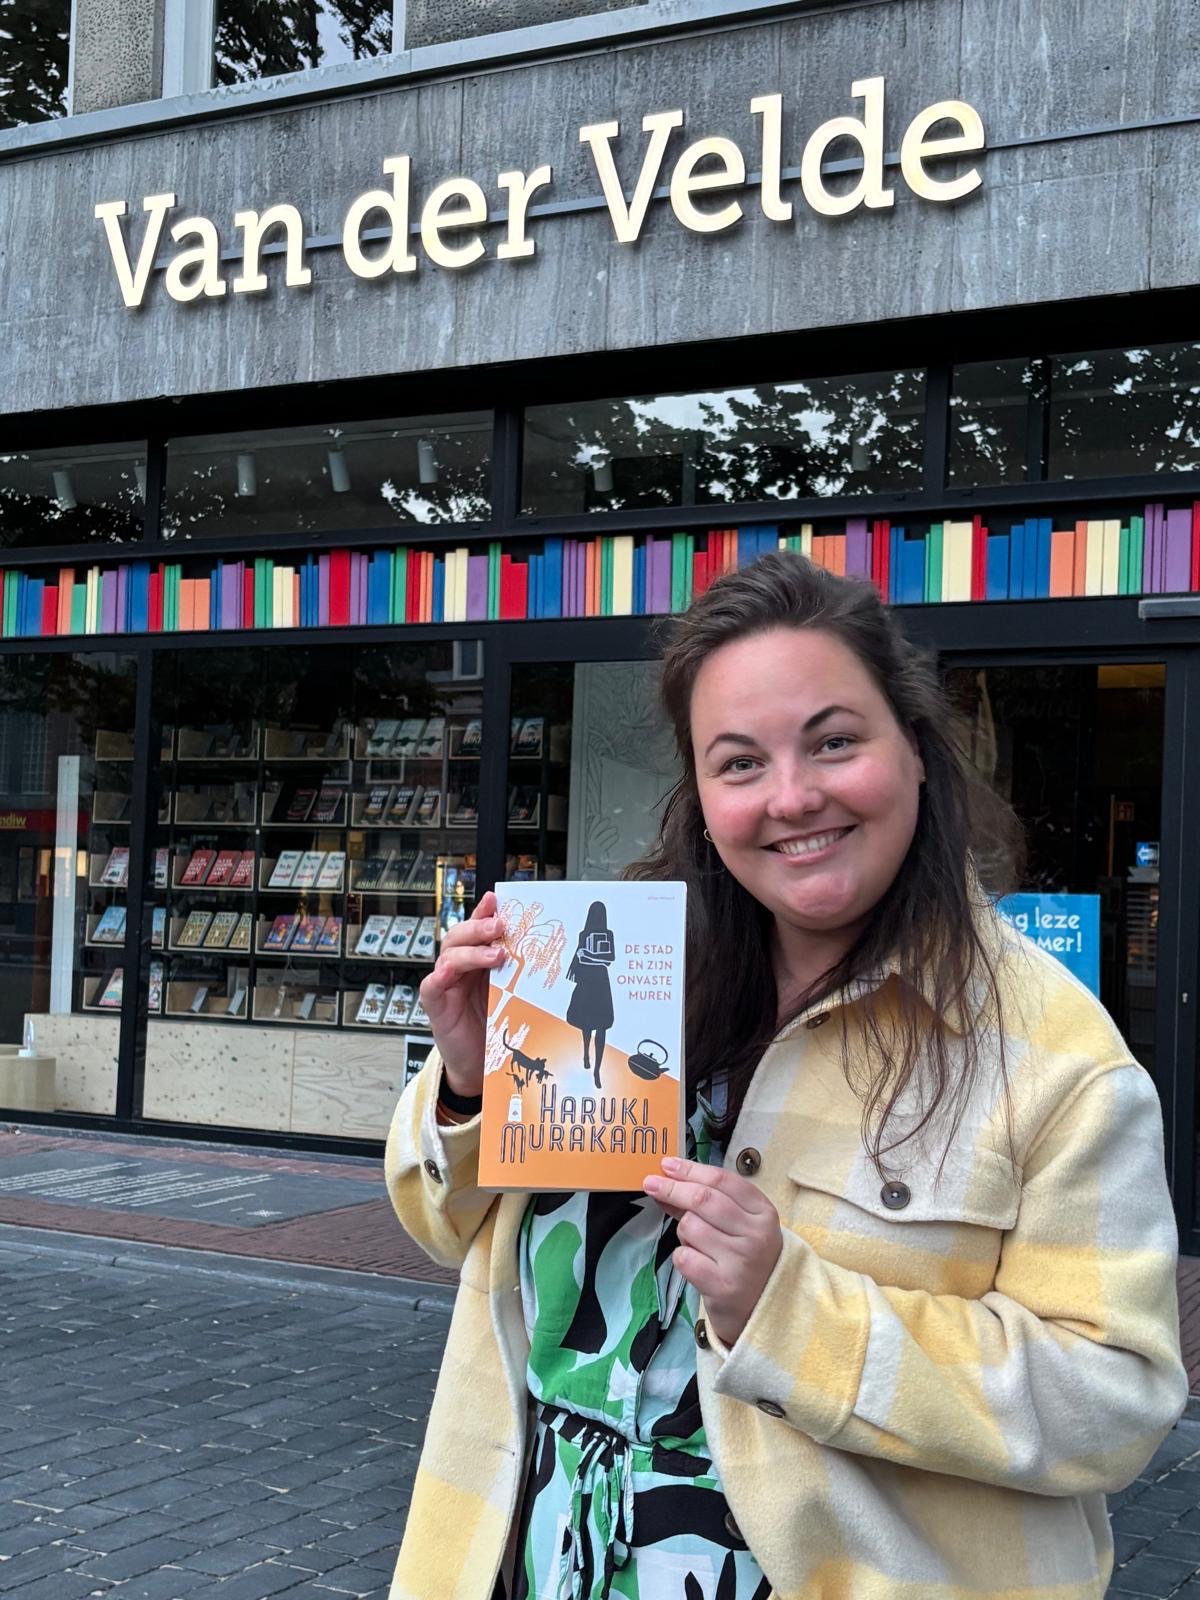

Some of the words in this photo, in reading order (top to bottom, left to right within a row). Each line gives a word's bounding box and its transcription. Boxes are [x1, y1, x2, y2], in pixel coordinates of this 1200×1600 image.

[94, 192, 312, 308] Van
[342, 155, 552, 280] der
[578, 75, 986, 244] Velde
[1035, 906, 1080, 929] leze
[625, 944, 640, 954] DE
[643, 944, 673, 955] STAD
[628, 960, 644, 970] EN
[647, 960, 673, 970] ZIJN
[616, 975, 673, 986] ONVASTE
[628, 990, 672, 1001] MUREN
[540, 1083, 649, 1126] HARUKI
[500, 1123, 668, 1164] MURAKAMI
